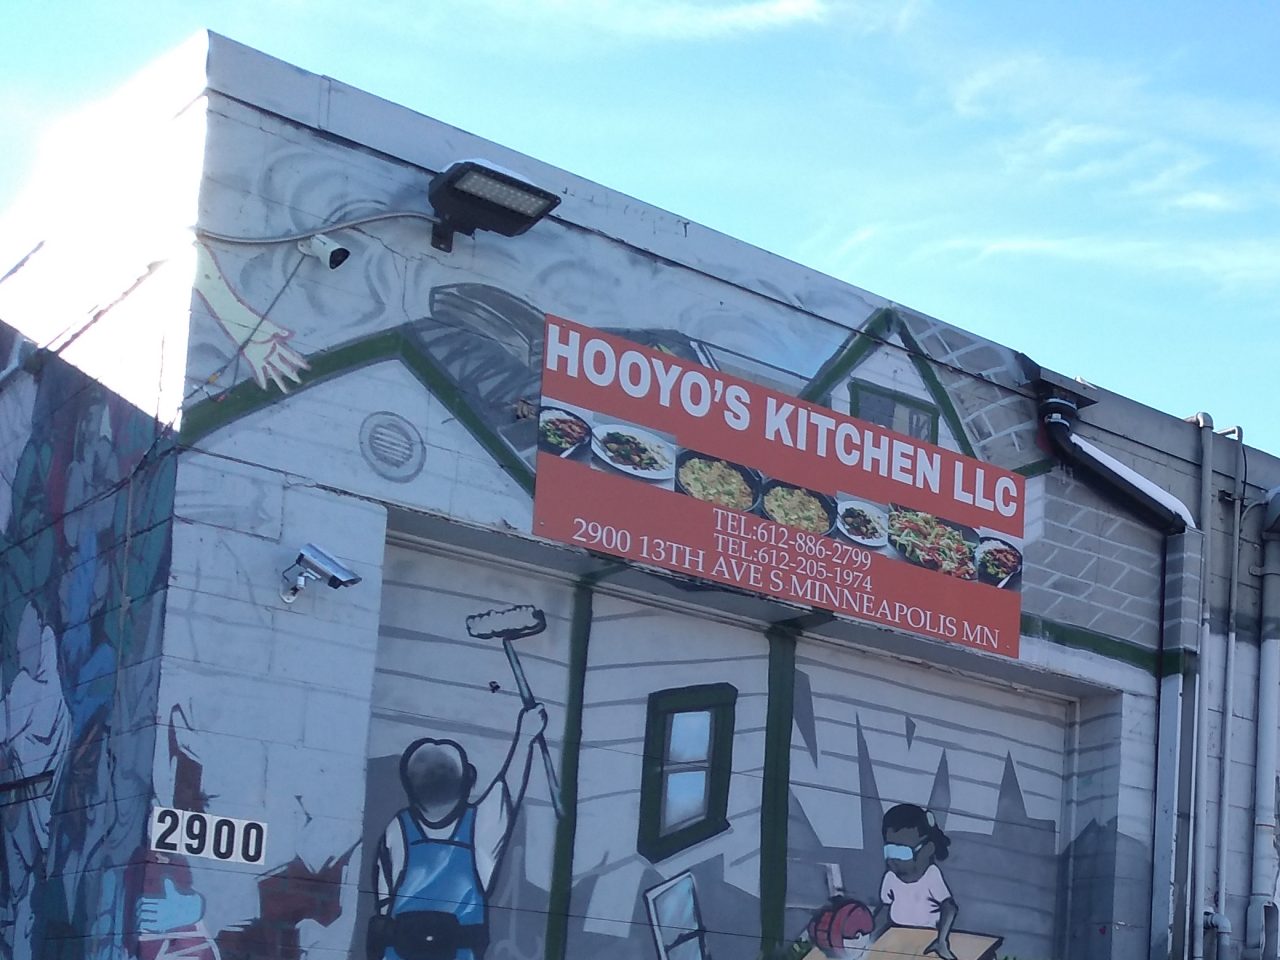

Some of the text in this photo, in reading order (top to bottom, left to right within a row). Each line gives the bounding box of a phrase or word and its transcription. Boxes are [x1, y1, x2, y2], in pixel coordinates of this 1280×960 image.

[546, 323, 1018, 518] HOOYO'S KITCHEN LLC
[713, 508, 872, 571] TEL:612-886-2799
[713, 533, 873, 593] TEL:612-205-1974
[572, 517, 1001, 649] 2900 13TH AVE S MINNEAPOLIS MN
[154, 809, 264, 862] 2900
